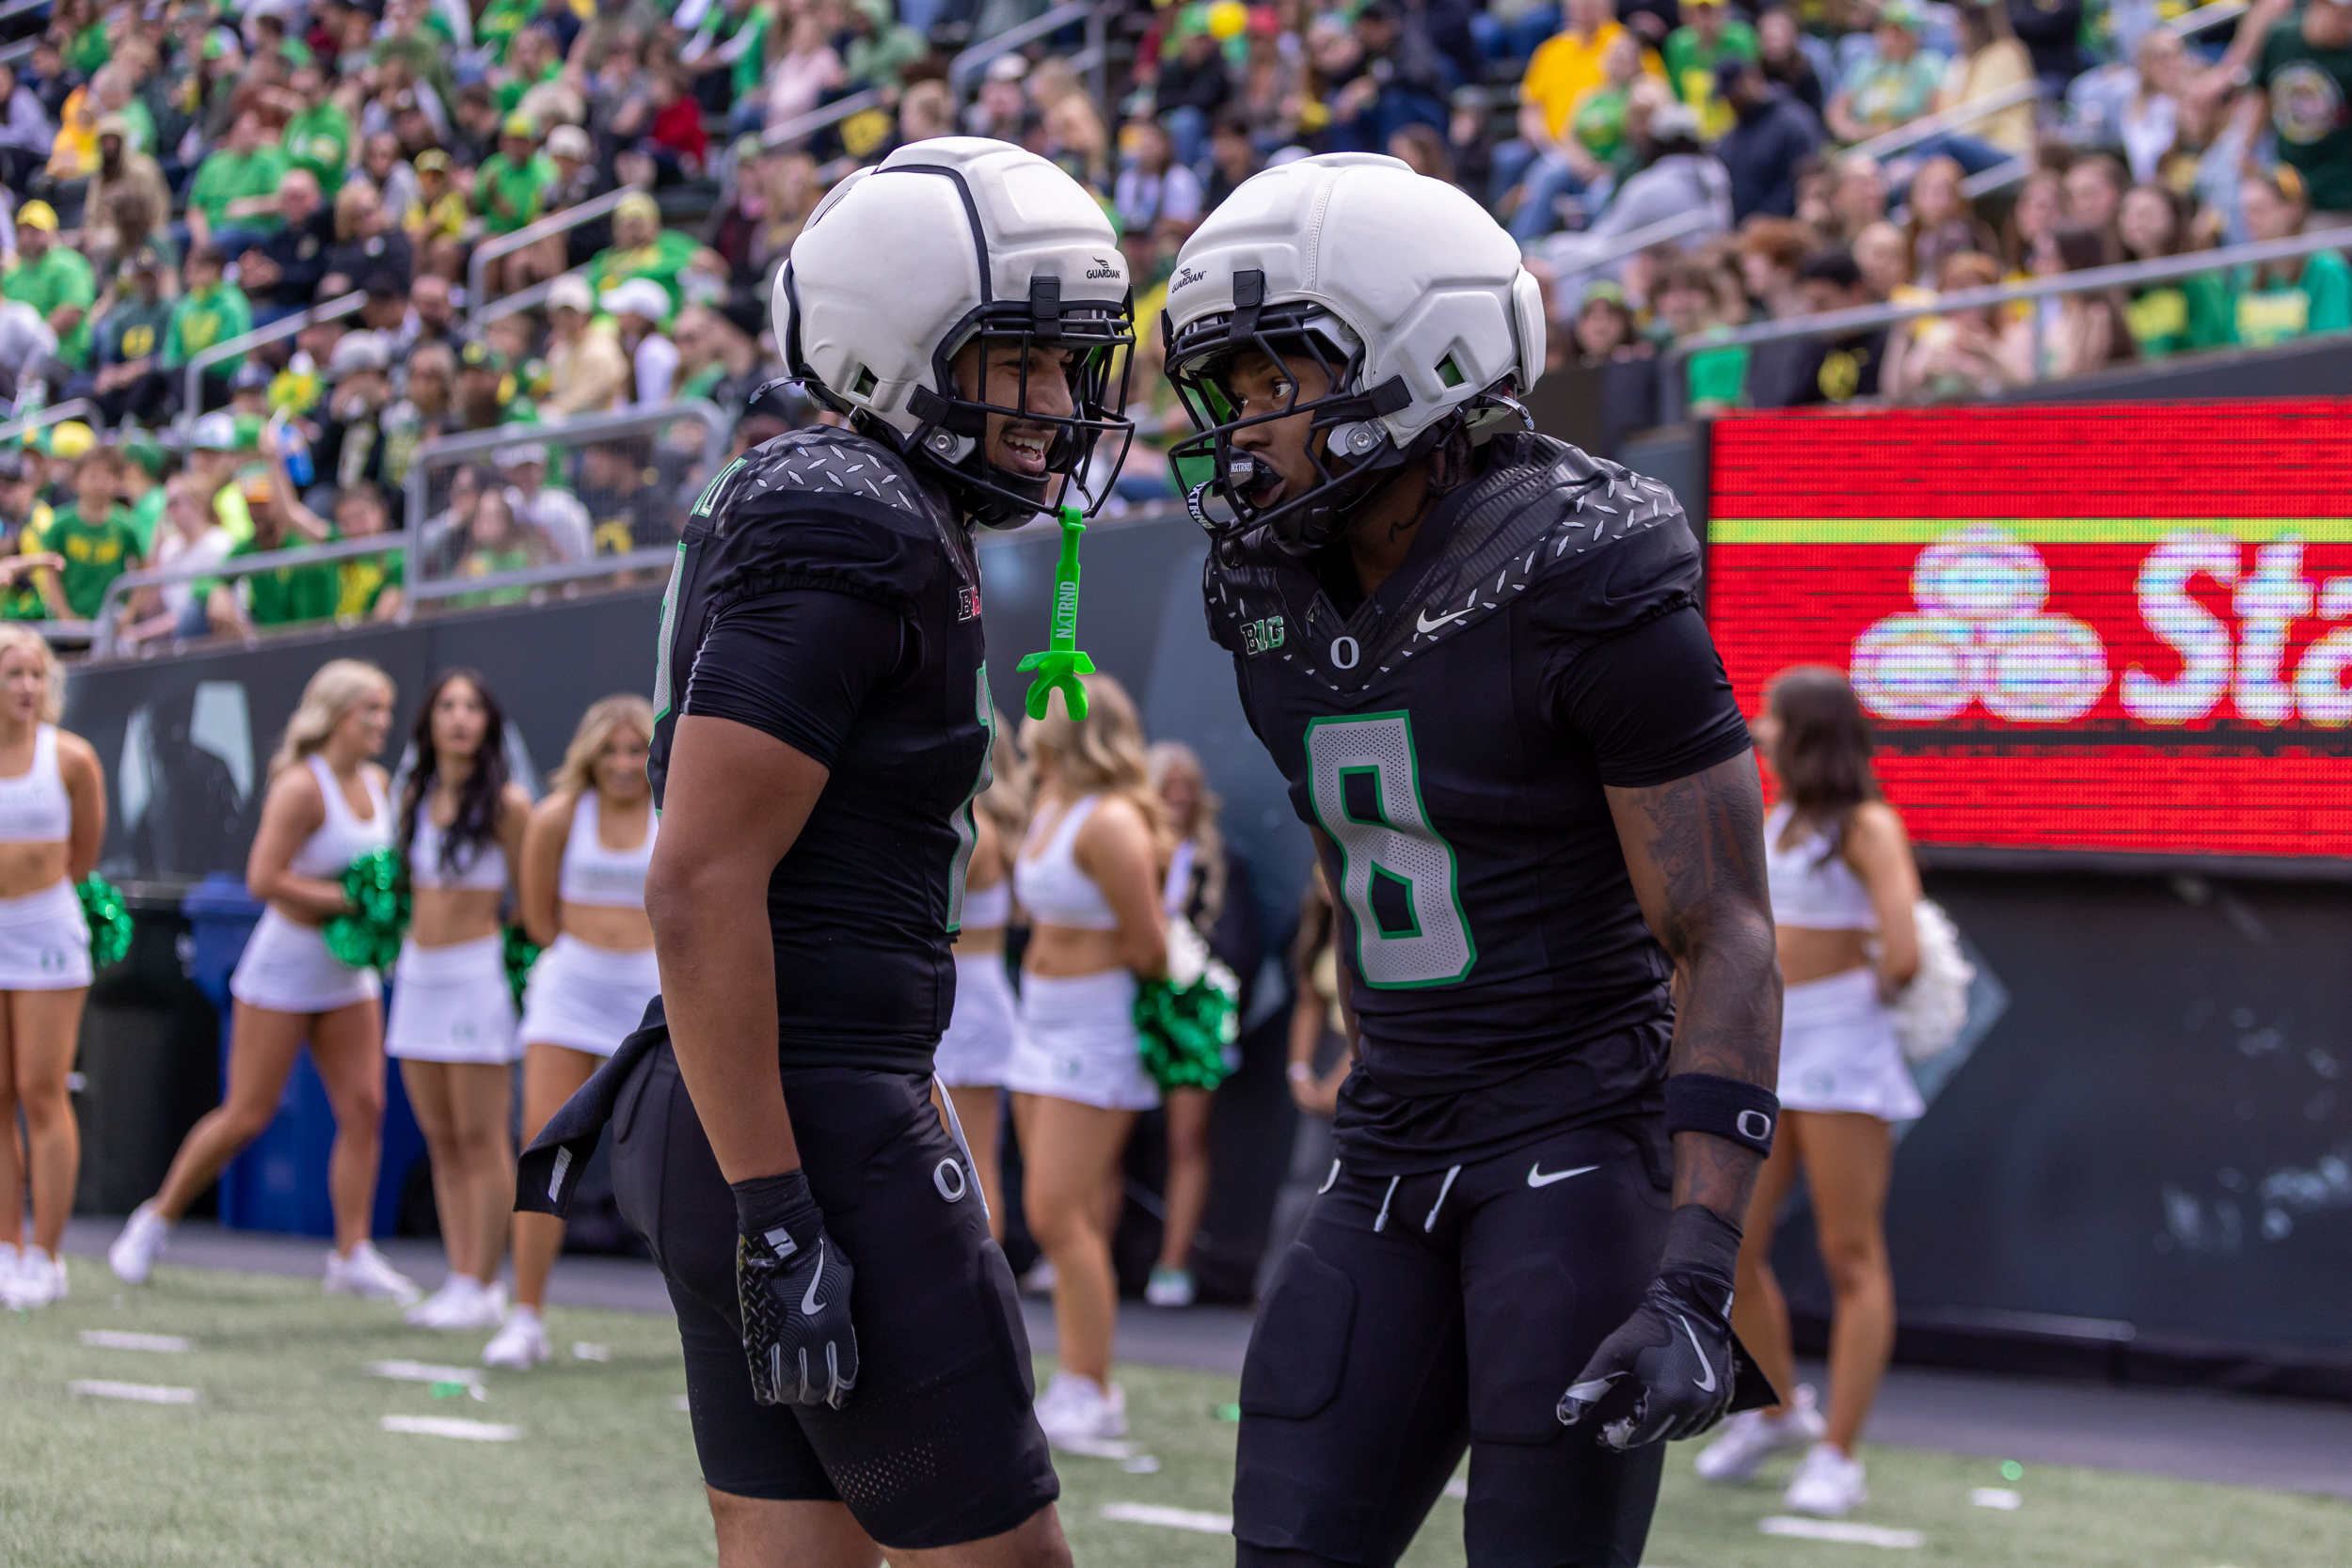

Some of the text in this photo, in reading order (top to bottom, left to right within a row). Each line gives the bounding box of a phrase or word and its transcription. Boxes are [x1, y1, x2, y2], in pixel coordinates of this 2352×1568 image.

[1086, 268, 1120, 279] GUARDIAN
[1171, 271, 1205, 294] GUARDIAN
[1056, 580, 1077, 639] NXTRND
[1303, 709, 1478, 990] 8
